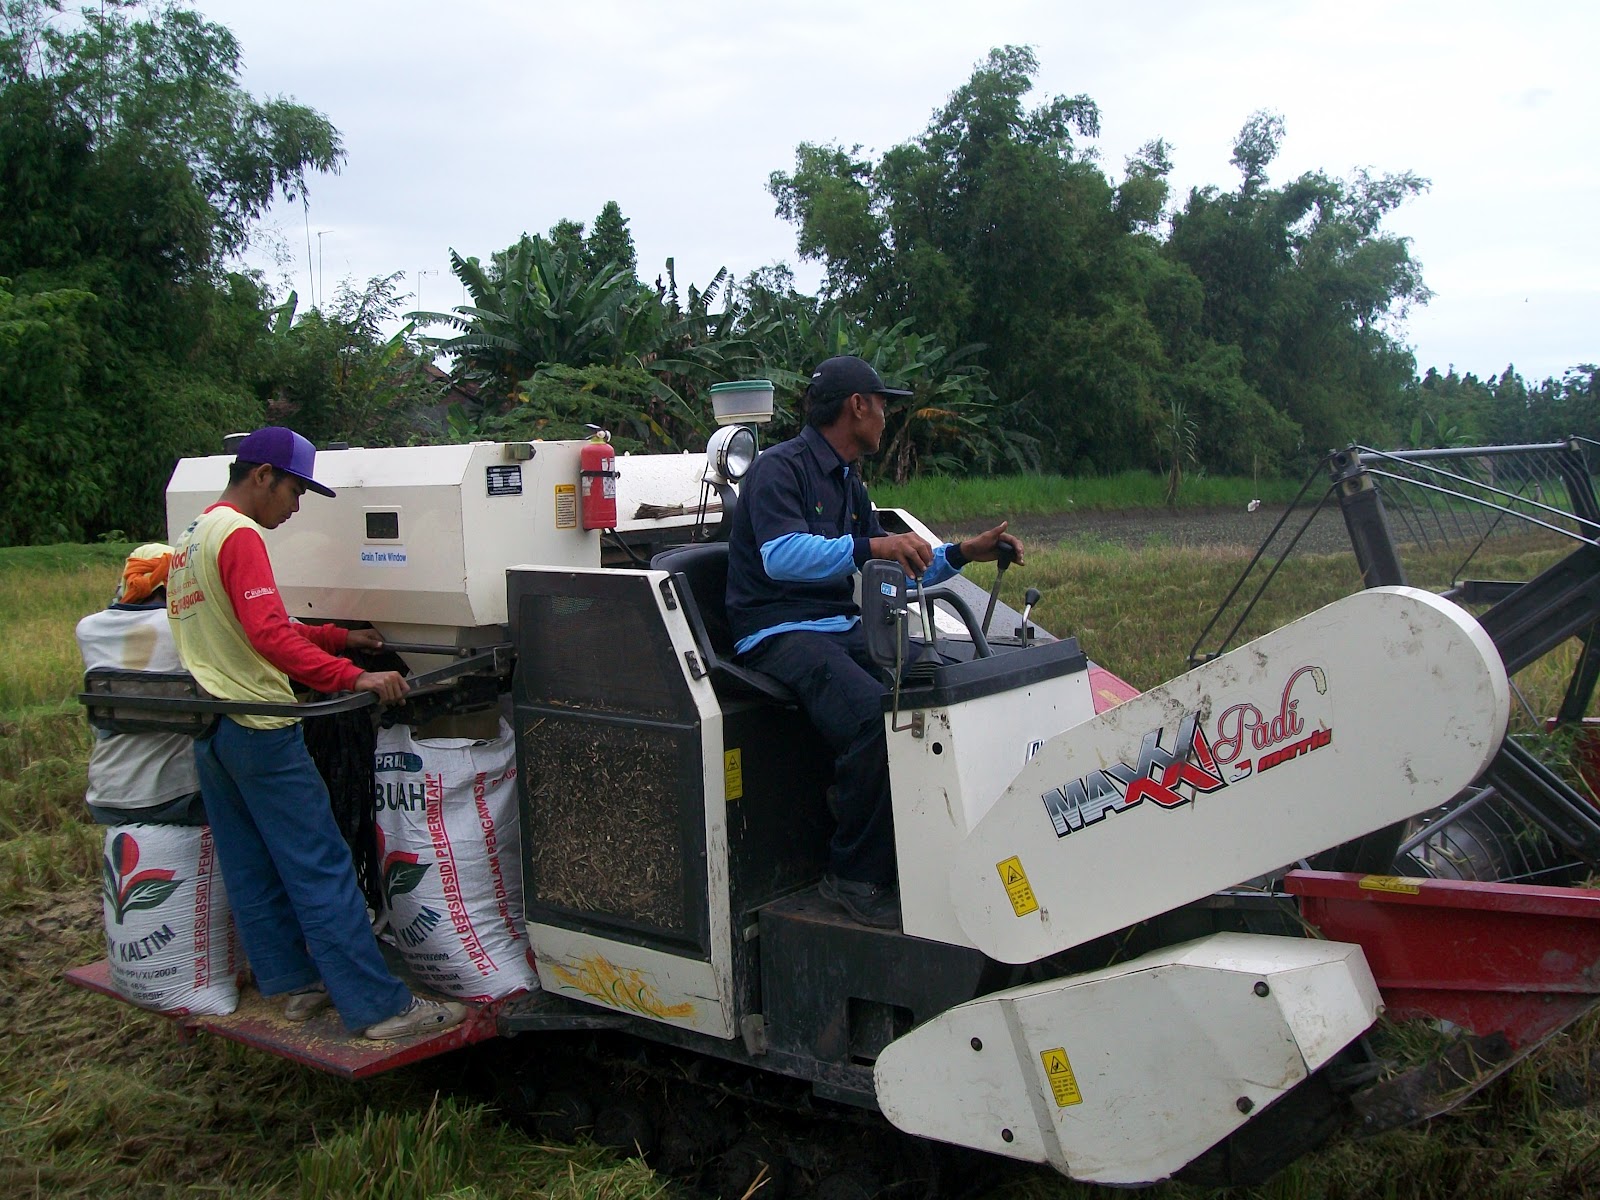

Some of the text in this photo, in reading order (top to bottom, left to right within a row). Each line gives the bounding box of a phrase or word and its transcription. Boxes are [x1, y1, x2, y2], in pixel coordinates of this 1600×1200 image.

[361, 552, 407, 562] Grain Tank Window
[1211, 666, 1326, 765] Padi
[473, 772, 497, 855] PENGAWASAN
[438, 858, 470, 934] BERSUBSIDI
[488, 856, 507, 899] DALAM
[120, 924, 176, 962] KALTIM
[194, 877, 208, 953] BERSUBSIDI
[399, 905, 442, 948] KALTIM
